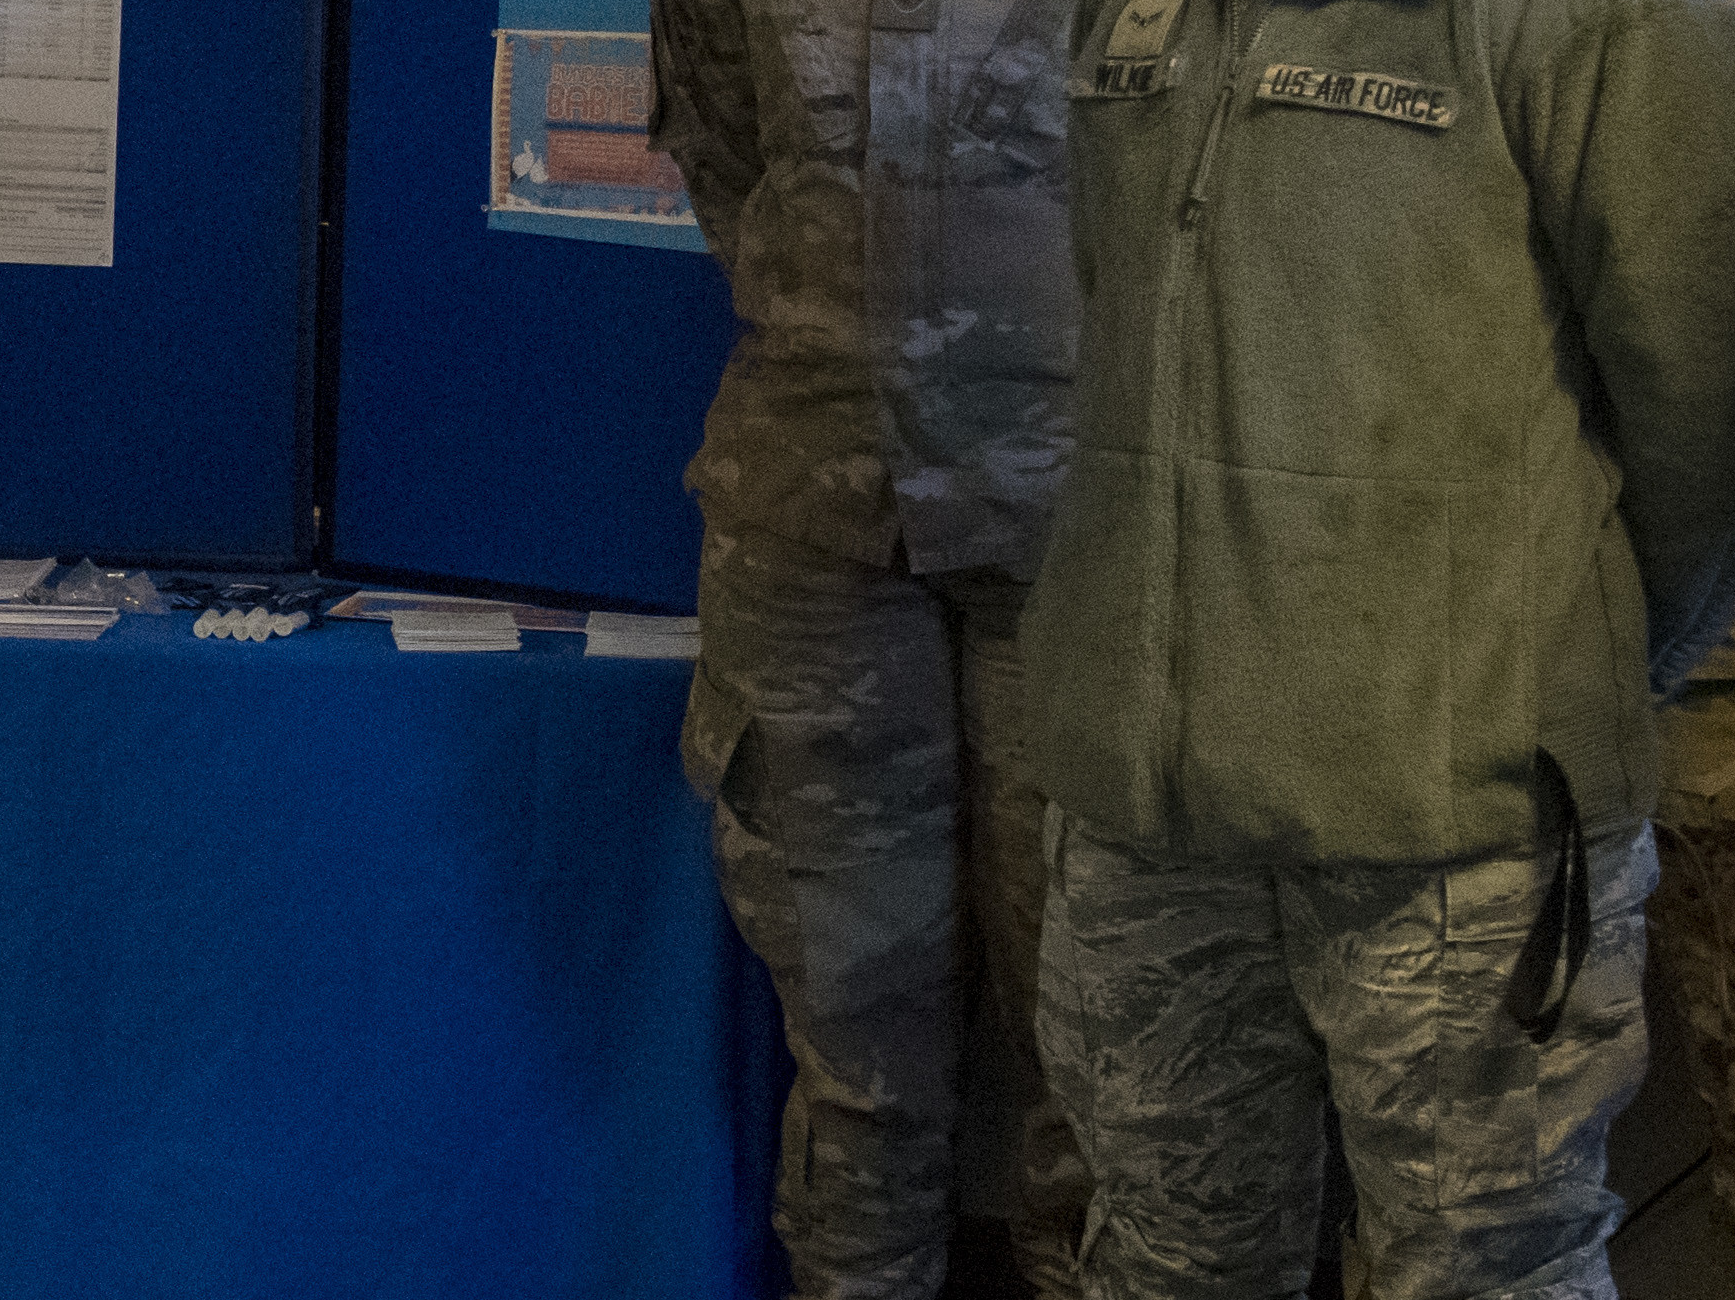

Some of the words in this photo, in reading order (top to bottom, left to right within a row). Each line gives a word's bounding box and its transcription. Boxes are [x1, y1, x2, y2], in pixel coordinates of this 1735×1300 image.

[1094, 63, 1155, 93] WILKE
[1314, 74, 1355, 105] AIR
[1358, 77, 1445, 123] FORCE
